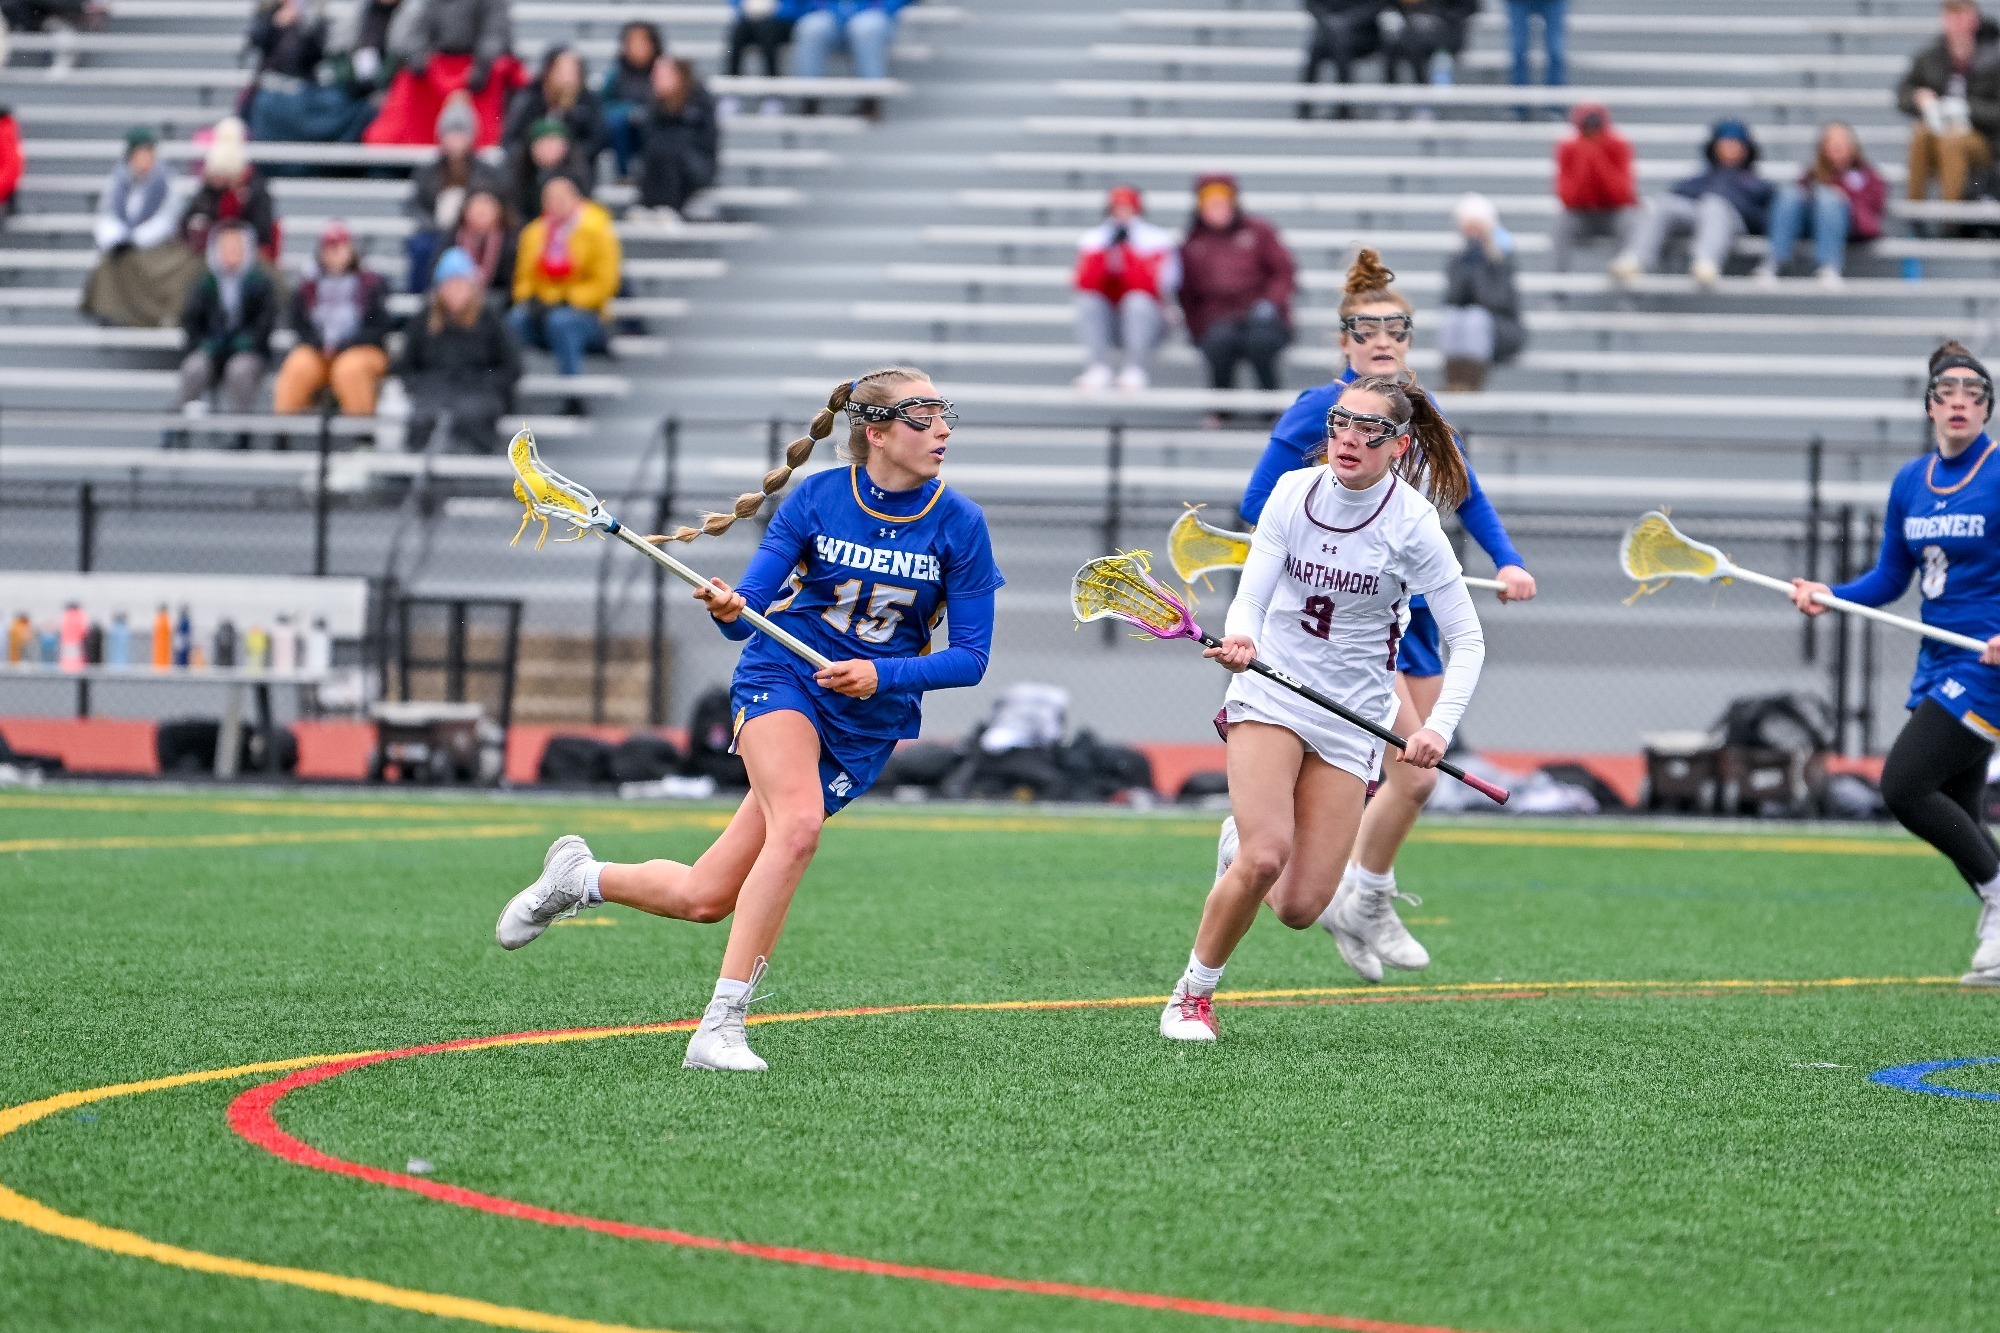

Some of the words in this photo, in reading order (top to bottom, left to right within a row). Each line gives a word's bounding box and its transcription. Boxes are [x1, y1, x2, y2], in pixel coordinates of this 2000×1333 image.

[866, 406, 889, 416] STX
[817, 535, 941, 580] WIDENER
[820, 579, 917, 643] 15
[1301, 595, 1335, 641] 9
